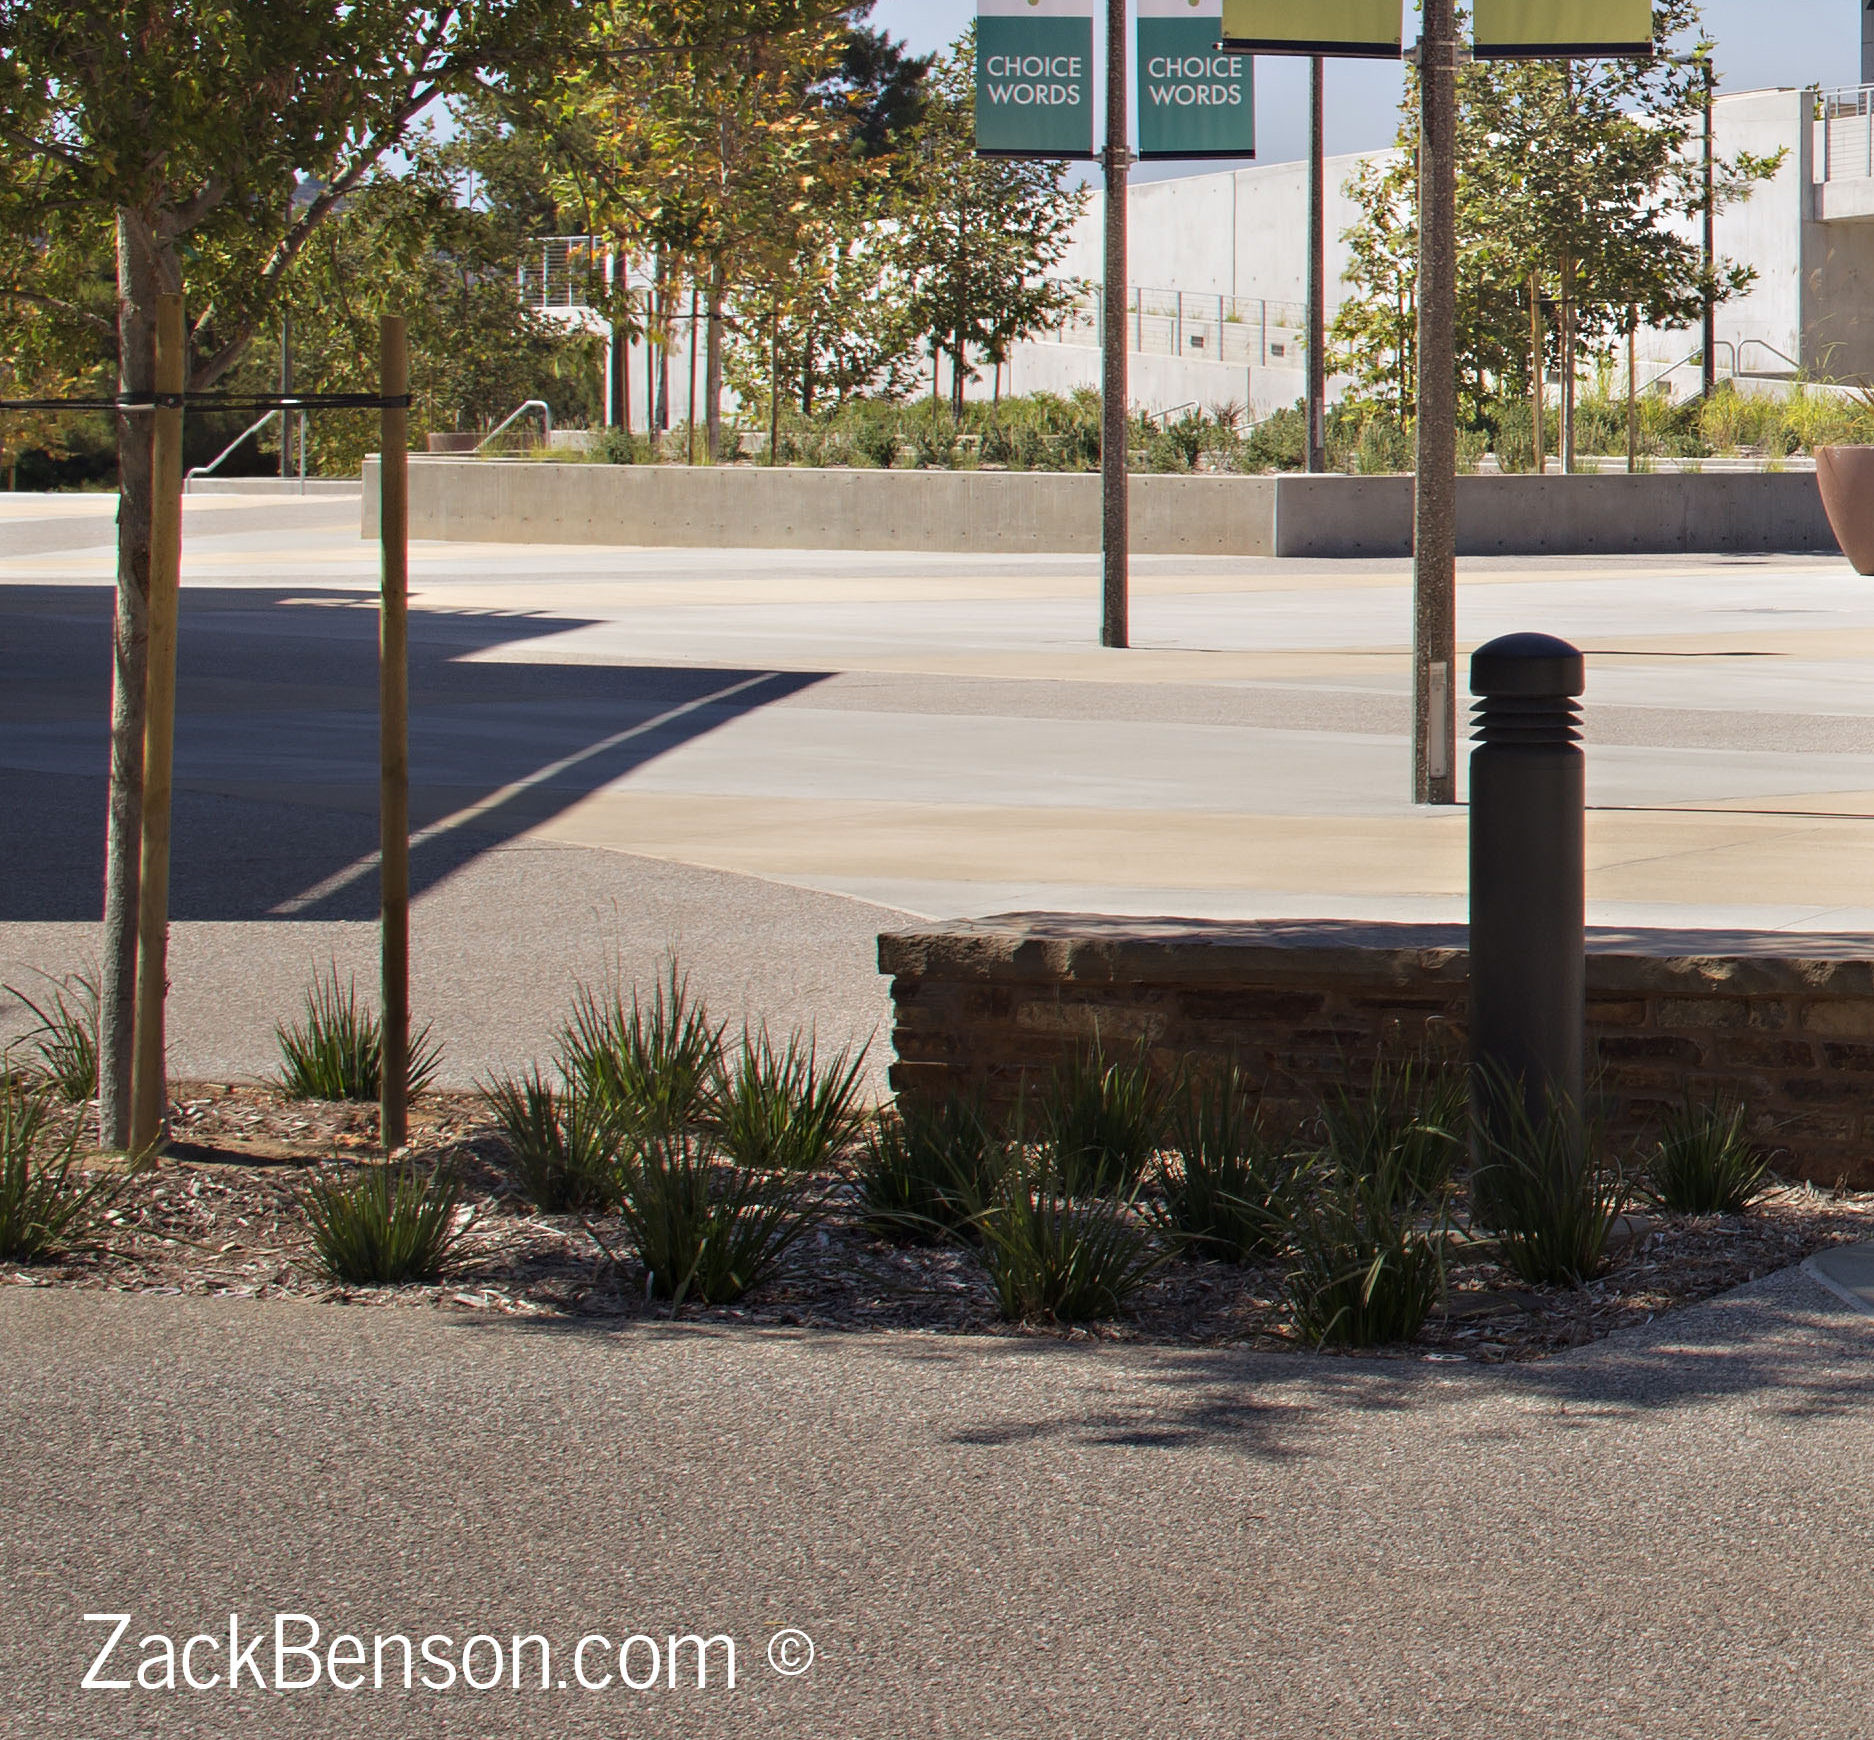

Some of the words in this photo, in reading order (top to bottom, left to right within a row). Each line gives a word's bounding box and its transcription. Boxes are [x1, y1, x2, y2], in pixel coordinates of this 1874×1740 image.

[986, 55, 1082, 79] CHOICE
[1148, 57, 1242, 78] CHOICE
[986, 83, 1081, 105] WORDS
[1149, 85, 1242, 105] WORDS
